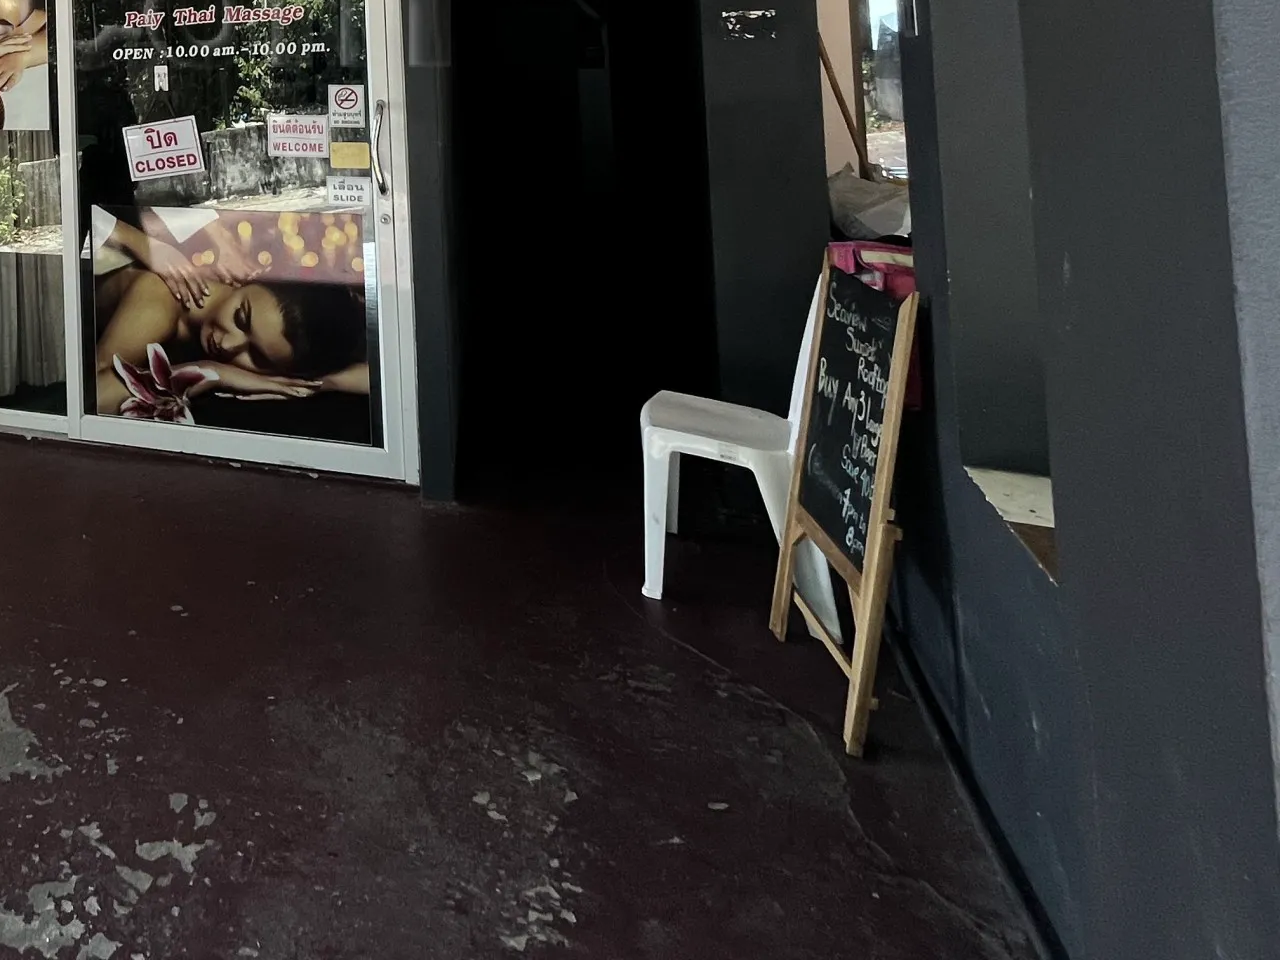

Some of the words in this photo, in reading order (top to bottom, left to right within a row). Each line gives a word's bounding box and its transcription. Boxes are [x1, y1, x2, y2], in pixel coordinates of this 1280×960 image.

[124, 8, 165, 31] Paiy
[172, 4, 216, 27] Thai
[222, 5, 304, 26] Massage
[112, 48, 154, 61] OPEN
[300, 41, 331, 56] pm.
[144, 127, 178, 149] ปิด
[272, 142, 324, 153] WELCOME
[135, 153, 198, 173] CLOSED
[333, 194, 364, 202] SLIDE
[818, 356, 839, 427] Buy
